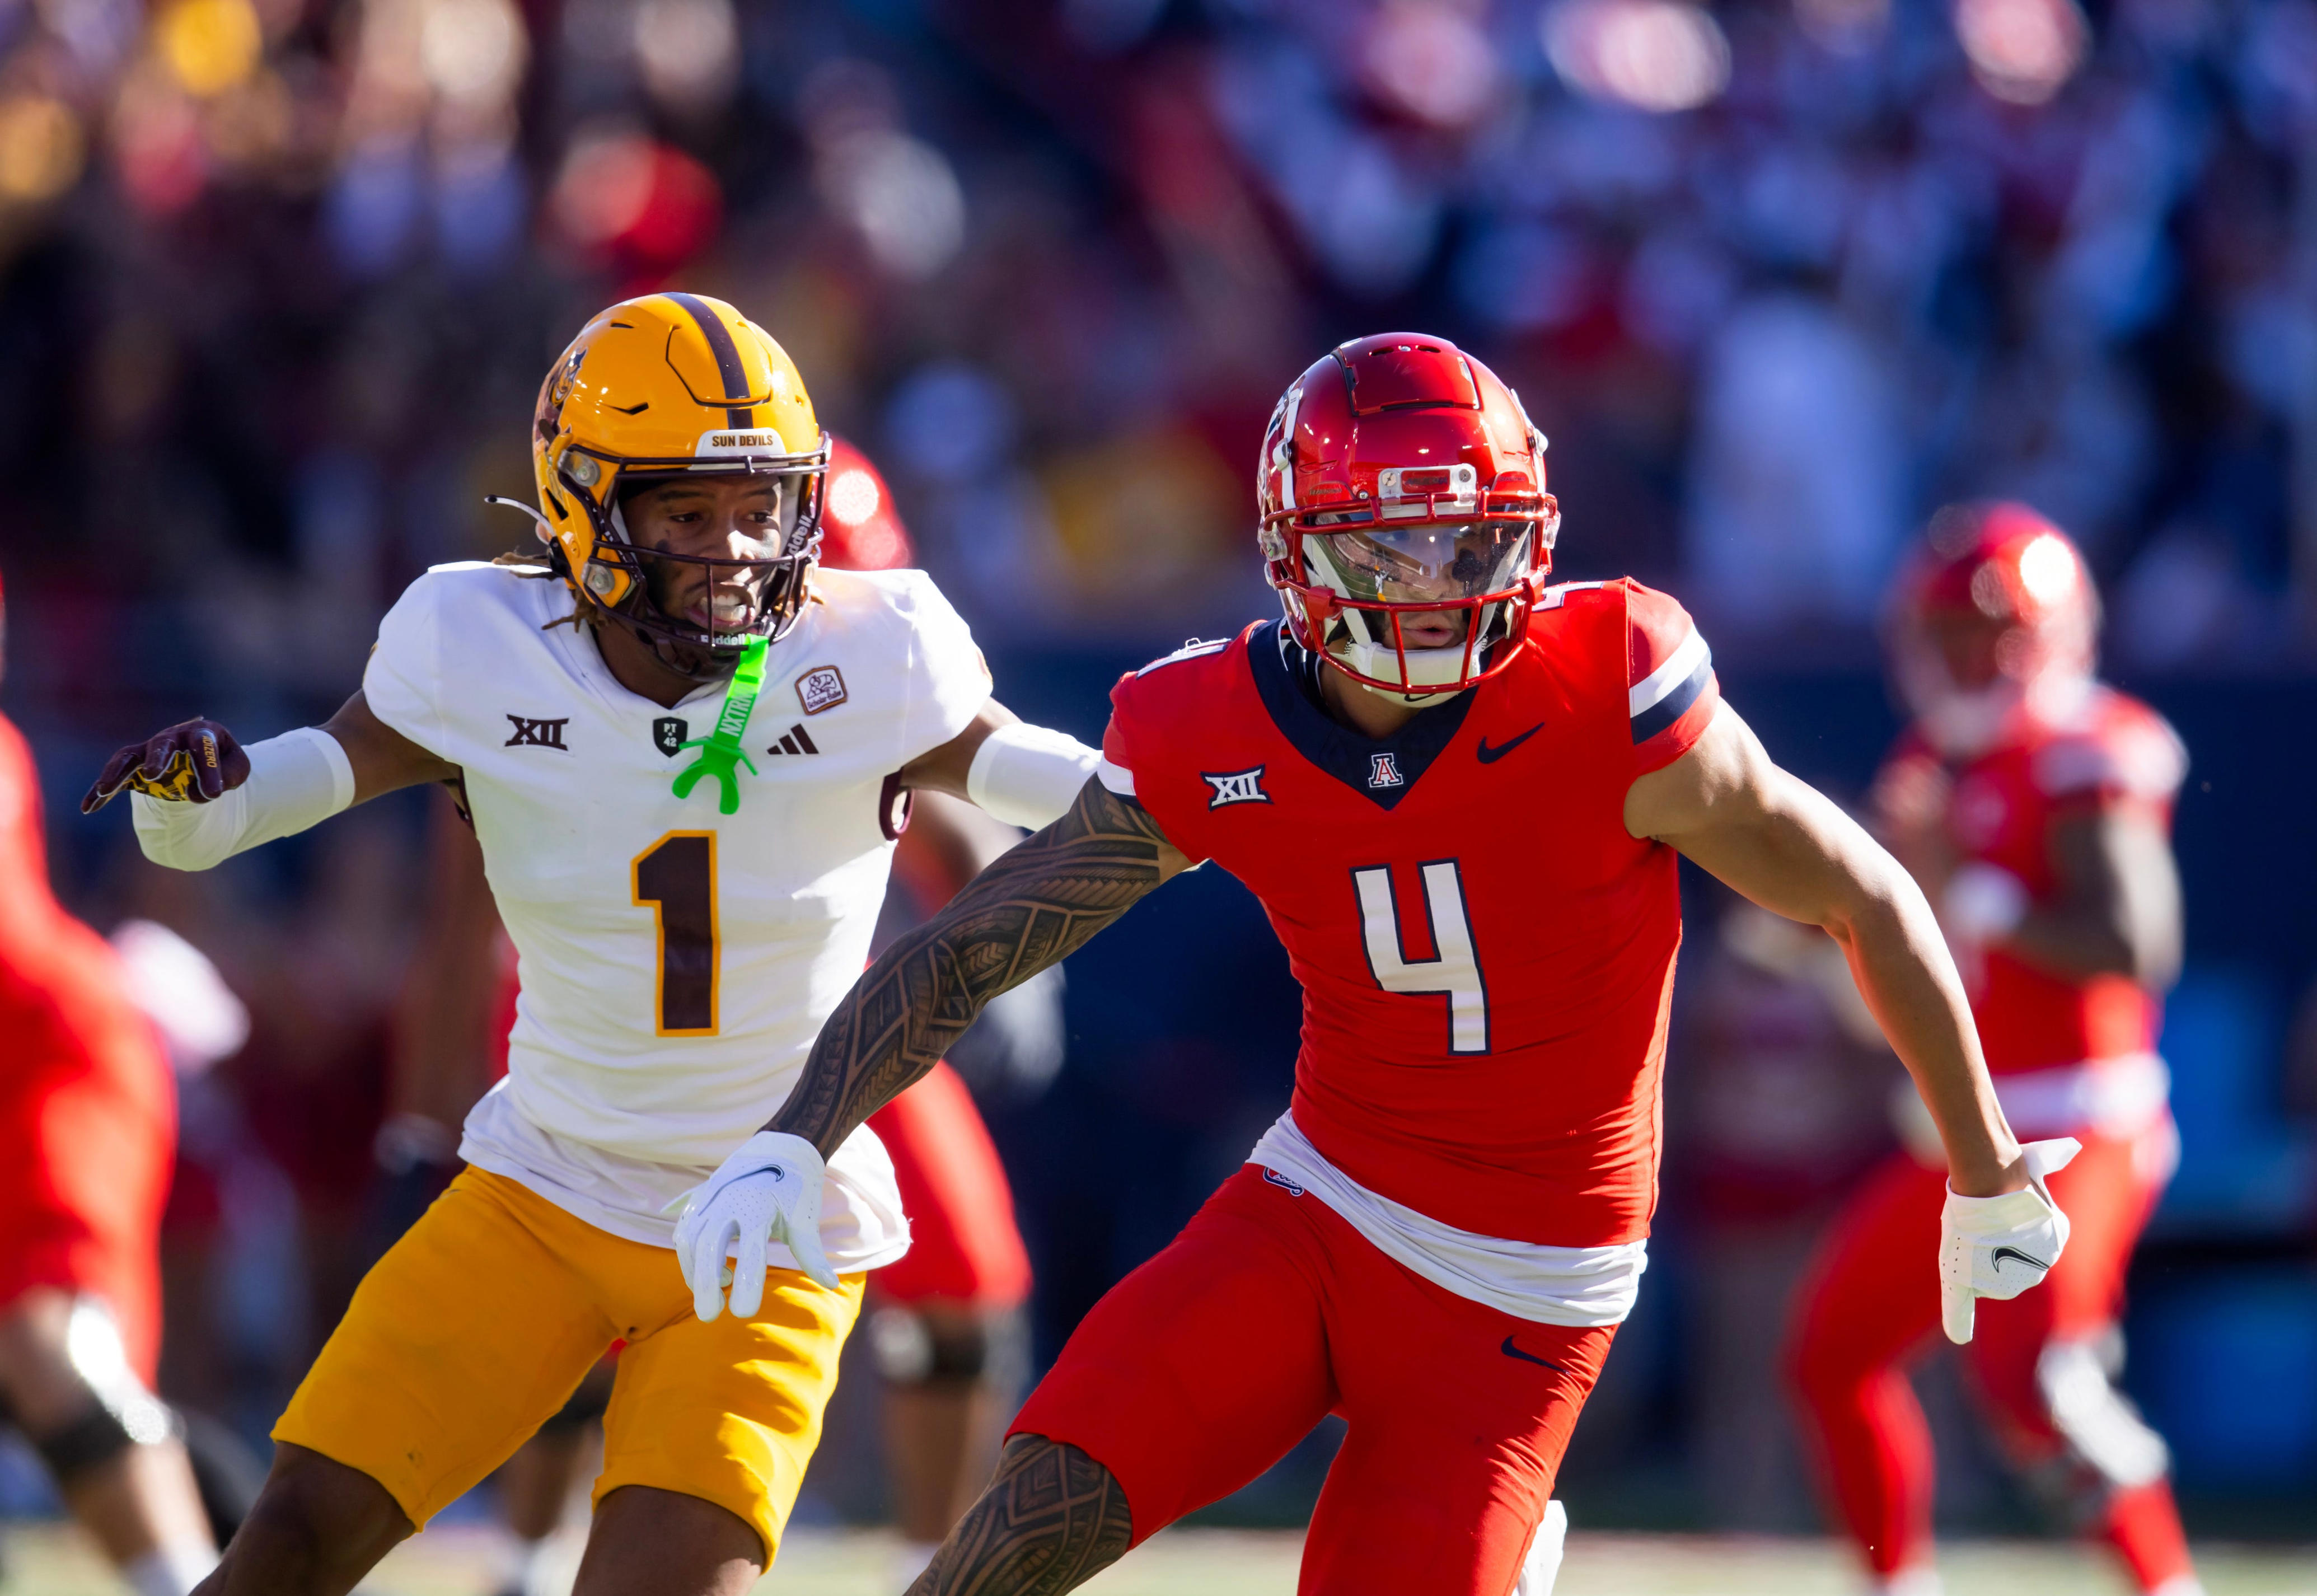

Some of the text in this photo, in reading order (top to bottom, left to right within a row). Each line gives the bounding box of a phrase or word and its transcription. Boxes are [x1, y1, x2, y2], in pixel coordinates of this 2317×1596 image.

[712, 435, 773, 447] SUN DEVILS
[778, 514, 812, 571] Rddell
[504, 714, 569, 751] XII
[663, 723, 677, 733] PT
[663, 737, 677, 747] 42
[1202, 765, 1271, 809] XII
[1369, 753, 1403, 787] A
[630, 829, 722, 1037] 1
[1349, 857, 1491, 1056] 4
